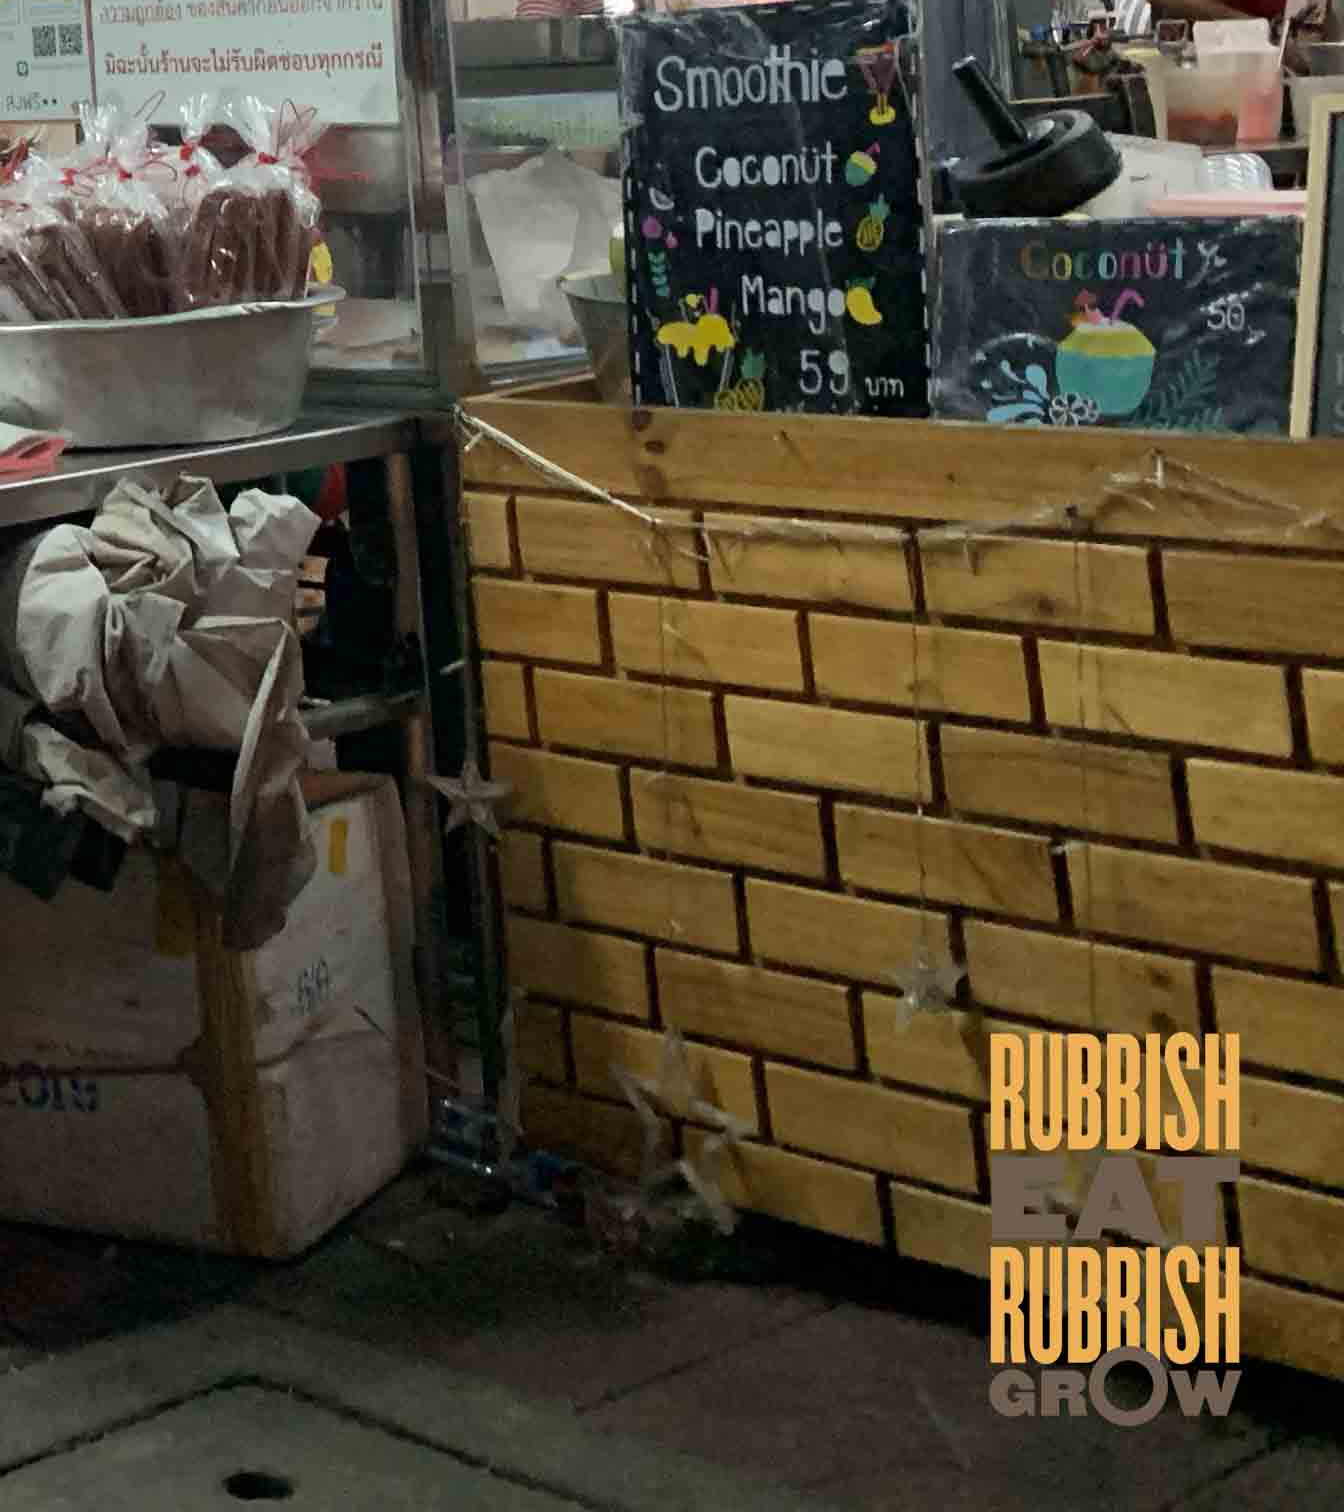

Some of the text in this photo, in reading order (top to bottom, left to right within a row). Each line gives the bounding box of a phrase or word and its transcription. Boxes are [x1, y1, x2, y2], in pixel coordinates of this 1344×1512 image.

[653, 44, 850, 113] Smoothie
[695, 208, 844, 257] Pineapple
[741, 273, 846, 335] Mango
[799, 349, 905, 398] 59 บาท
